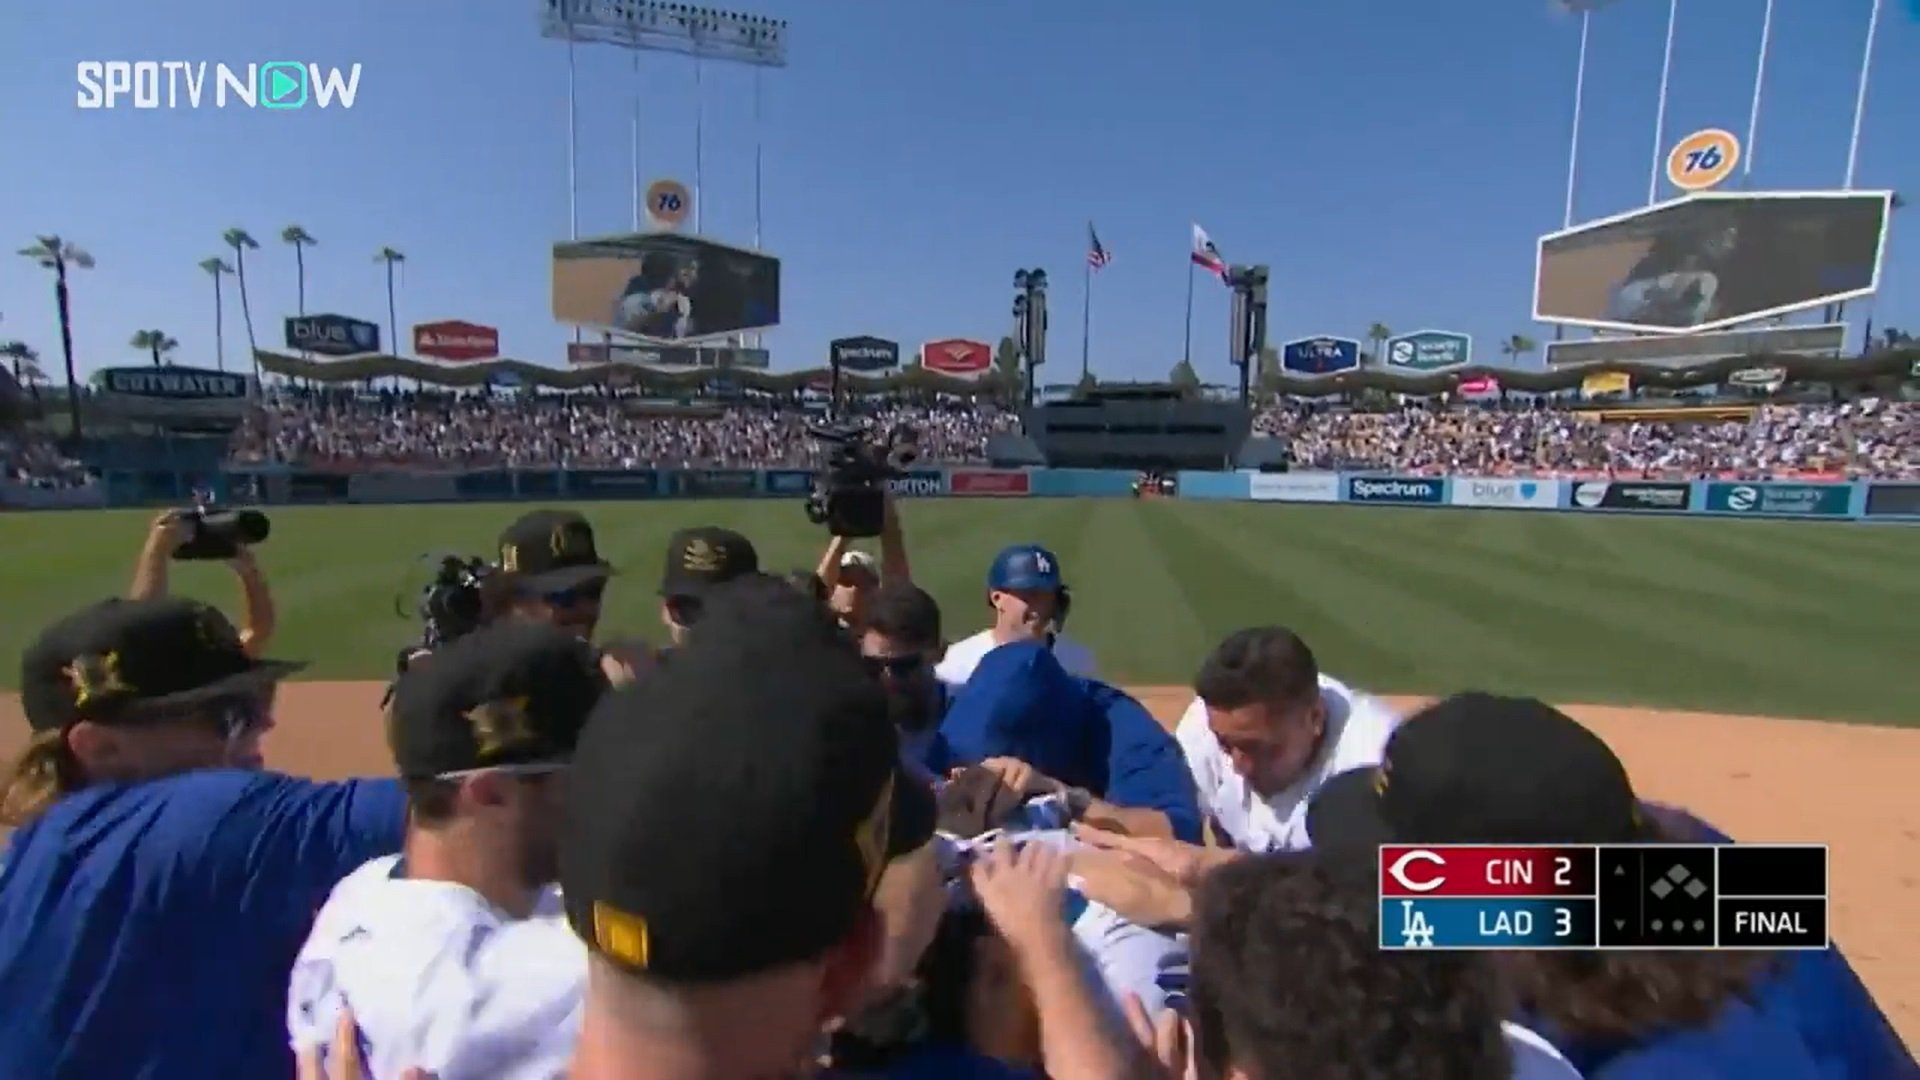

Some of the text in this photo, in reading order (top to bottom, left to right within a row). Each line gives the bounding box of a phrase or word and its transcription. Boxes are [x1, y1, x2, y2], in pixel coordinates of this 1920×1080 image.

[1685, 145, 1722, 173] 76
[658, 192, 681, 212] 76
[1298, 347, 1343, 358] ULTRA
[1353, 480, 1430, 498] Spectrum
